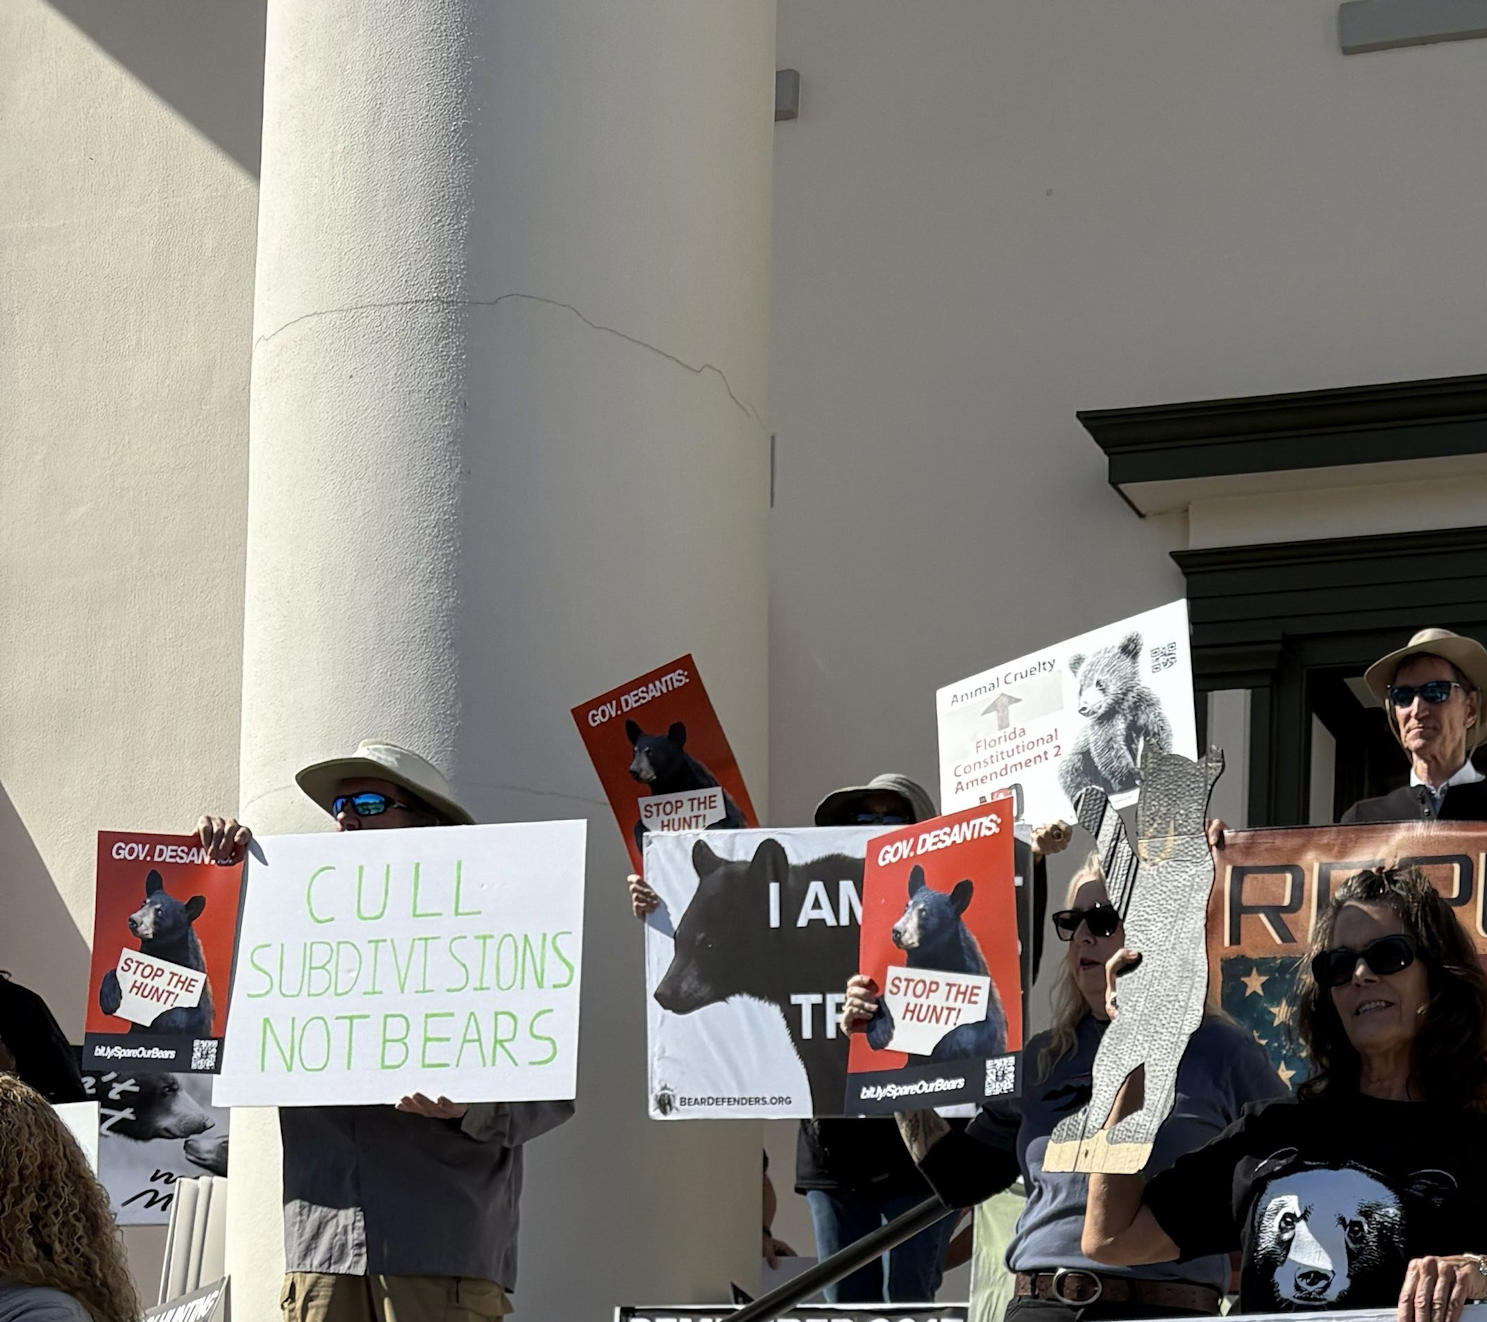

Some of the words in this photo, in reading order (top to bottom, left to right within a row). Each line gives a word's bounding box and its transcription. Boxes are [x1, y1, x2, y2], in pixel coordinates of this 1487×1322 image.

[587, 701, 622, 727] GOV.
[620, 669, 690, 712] DESANTIS:
[951, 677, 1000, 706] Animal
[1004, 659, 1056, 685] Cruelty
[954, 728, 1060, 778] Constitutional
[975, 726, 1027, 753] Florida
[954, 749, 1050, 795] Amendment
[1053, 744, 1062, 758] 2
[644, 799, 683, 819] STOP
[688, 794, 717, 811] THE
[660, 814, 707, 831] HUNT!
[112, 842, 150, 861] GOV.
[877, 836, 916, 867] GOV.
[916, 813, 1002, 856] DESANTIS:
[305, 859, 483, 925] CULL
[768, 881, 781, 929] I
[121, 957, 165, 981] STOP
[167, 971, 199, 993] THE
[246, 930, 575, 999] SUBDIVISIONS
[129, 980, 179, 1007] HUNT!
[888, 975, 940, 1002] STOP
[944, 982, 982, 1005] THE
[901, 1002, 962, 1027] HUNT!
[260, 1014, 372, 1073] NOT
[381, 1008, 558, 1071] BEARS
